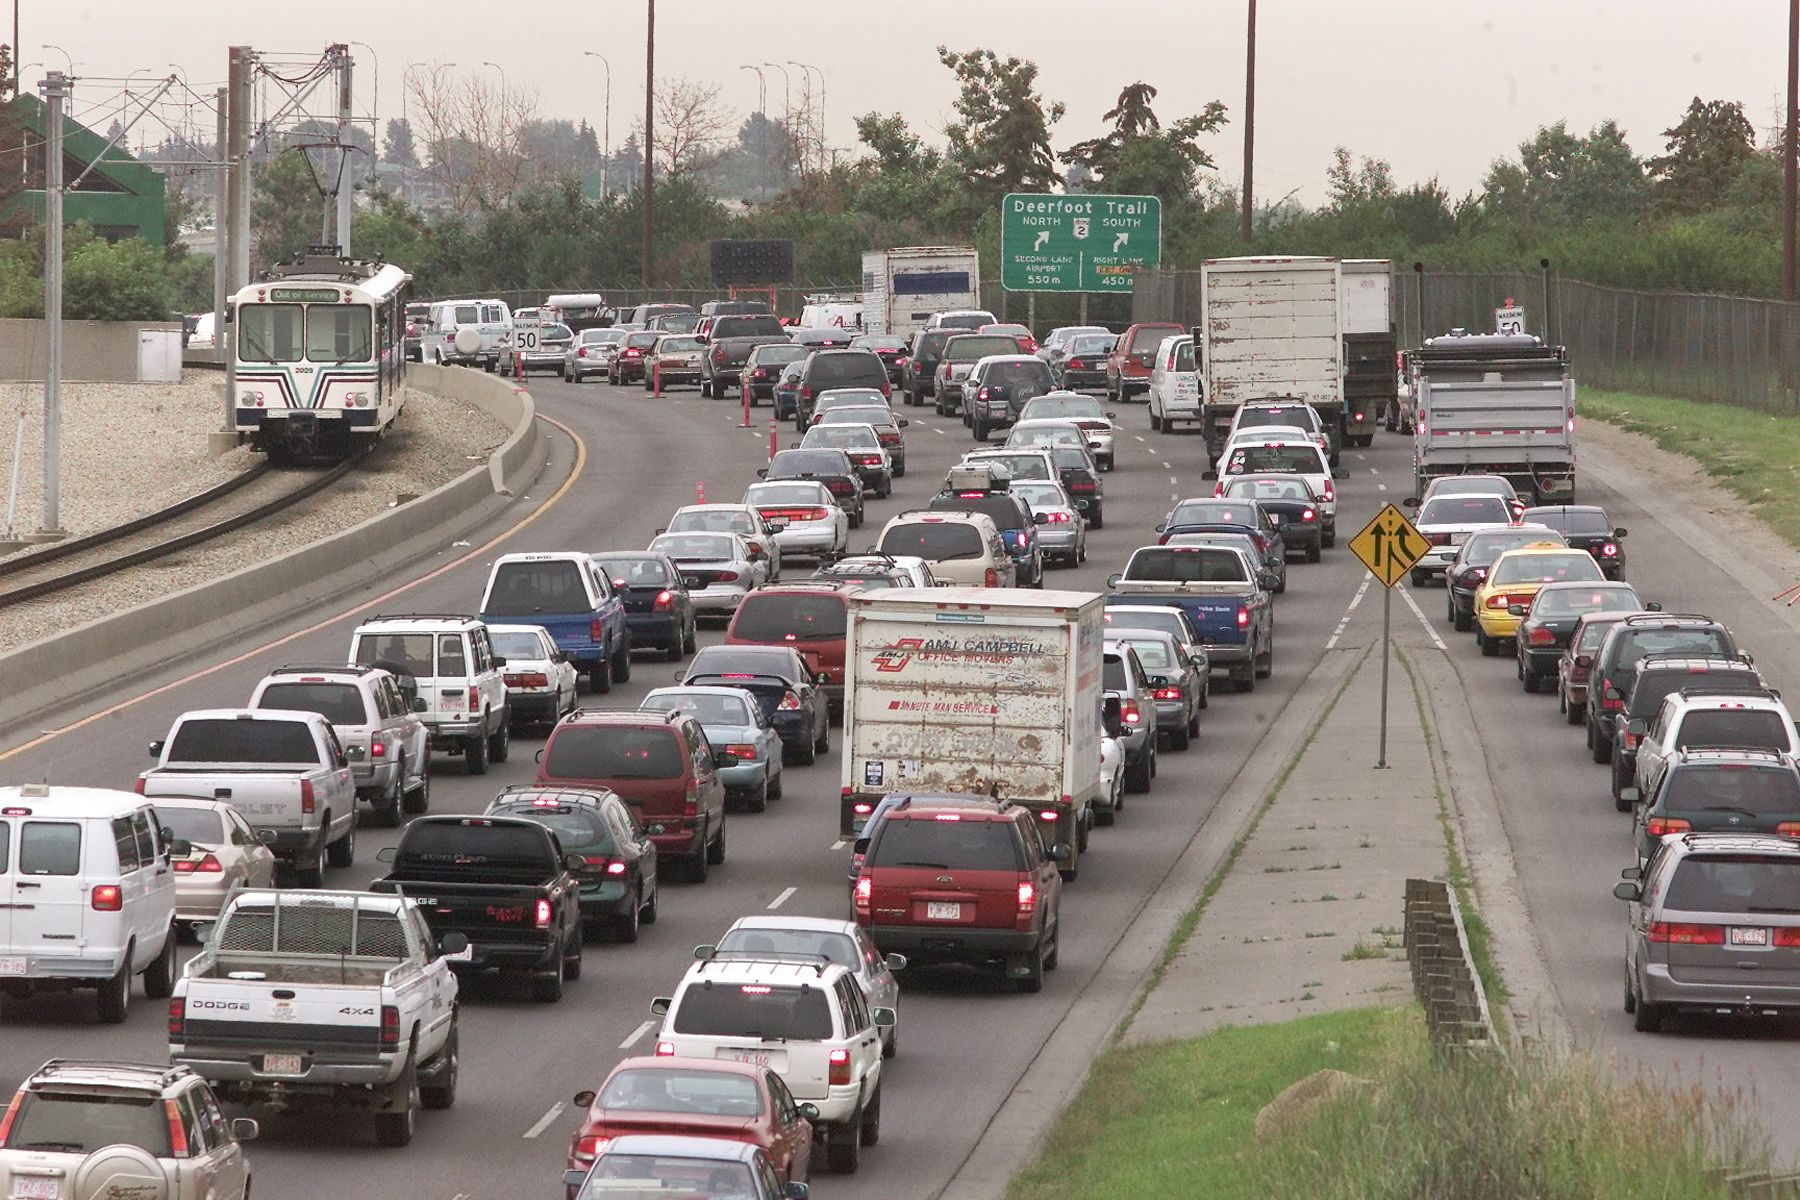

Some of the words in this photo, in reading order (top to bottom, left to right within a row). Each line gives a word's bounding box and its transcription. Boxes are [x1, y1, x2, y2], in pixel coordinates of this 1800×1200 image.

[1014, 200, 1093, 214] Deerfoot
[1106, 201, 1147, 215] Trail
[1023, 217, 1061, 226] NORTH
[1102, 218, 1142, 228] SOUTH
[1077, 226, 1086, 236] 2
[1015, 255, 1048, 263] SECOND
[1093, 256, 1119, 264] RIGHT
[1027, 275, 1049, 284] 550
[1102, 276, 1125, 285] 450
[517, 332, 536, 348] 50
[925, 639, 957, 650] AMJ
[964, 640, 1045, 654] CAMPBELL
[918, 652, 958, 662] OFFICE
[963, 654, 1015, 664] MOVERS
[900, 700, 929, 712] MINUTE
[933, 702, 950, 713] MAN
[953, 703, 990, 714] SERVICE
[193, 1000, 249, 1010] DODGE
